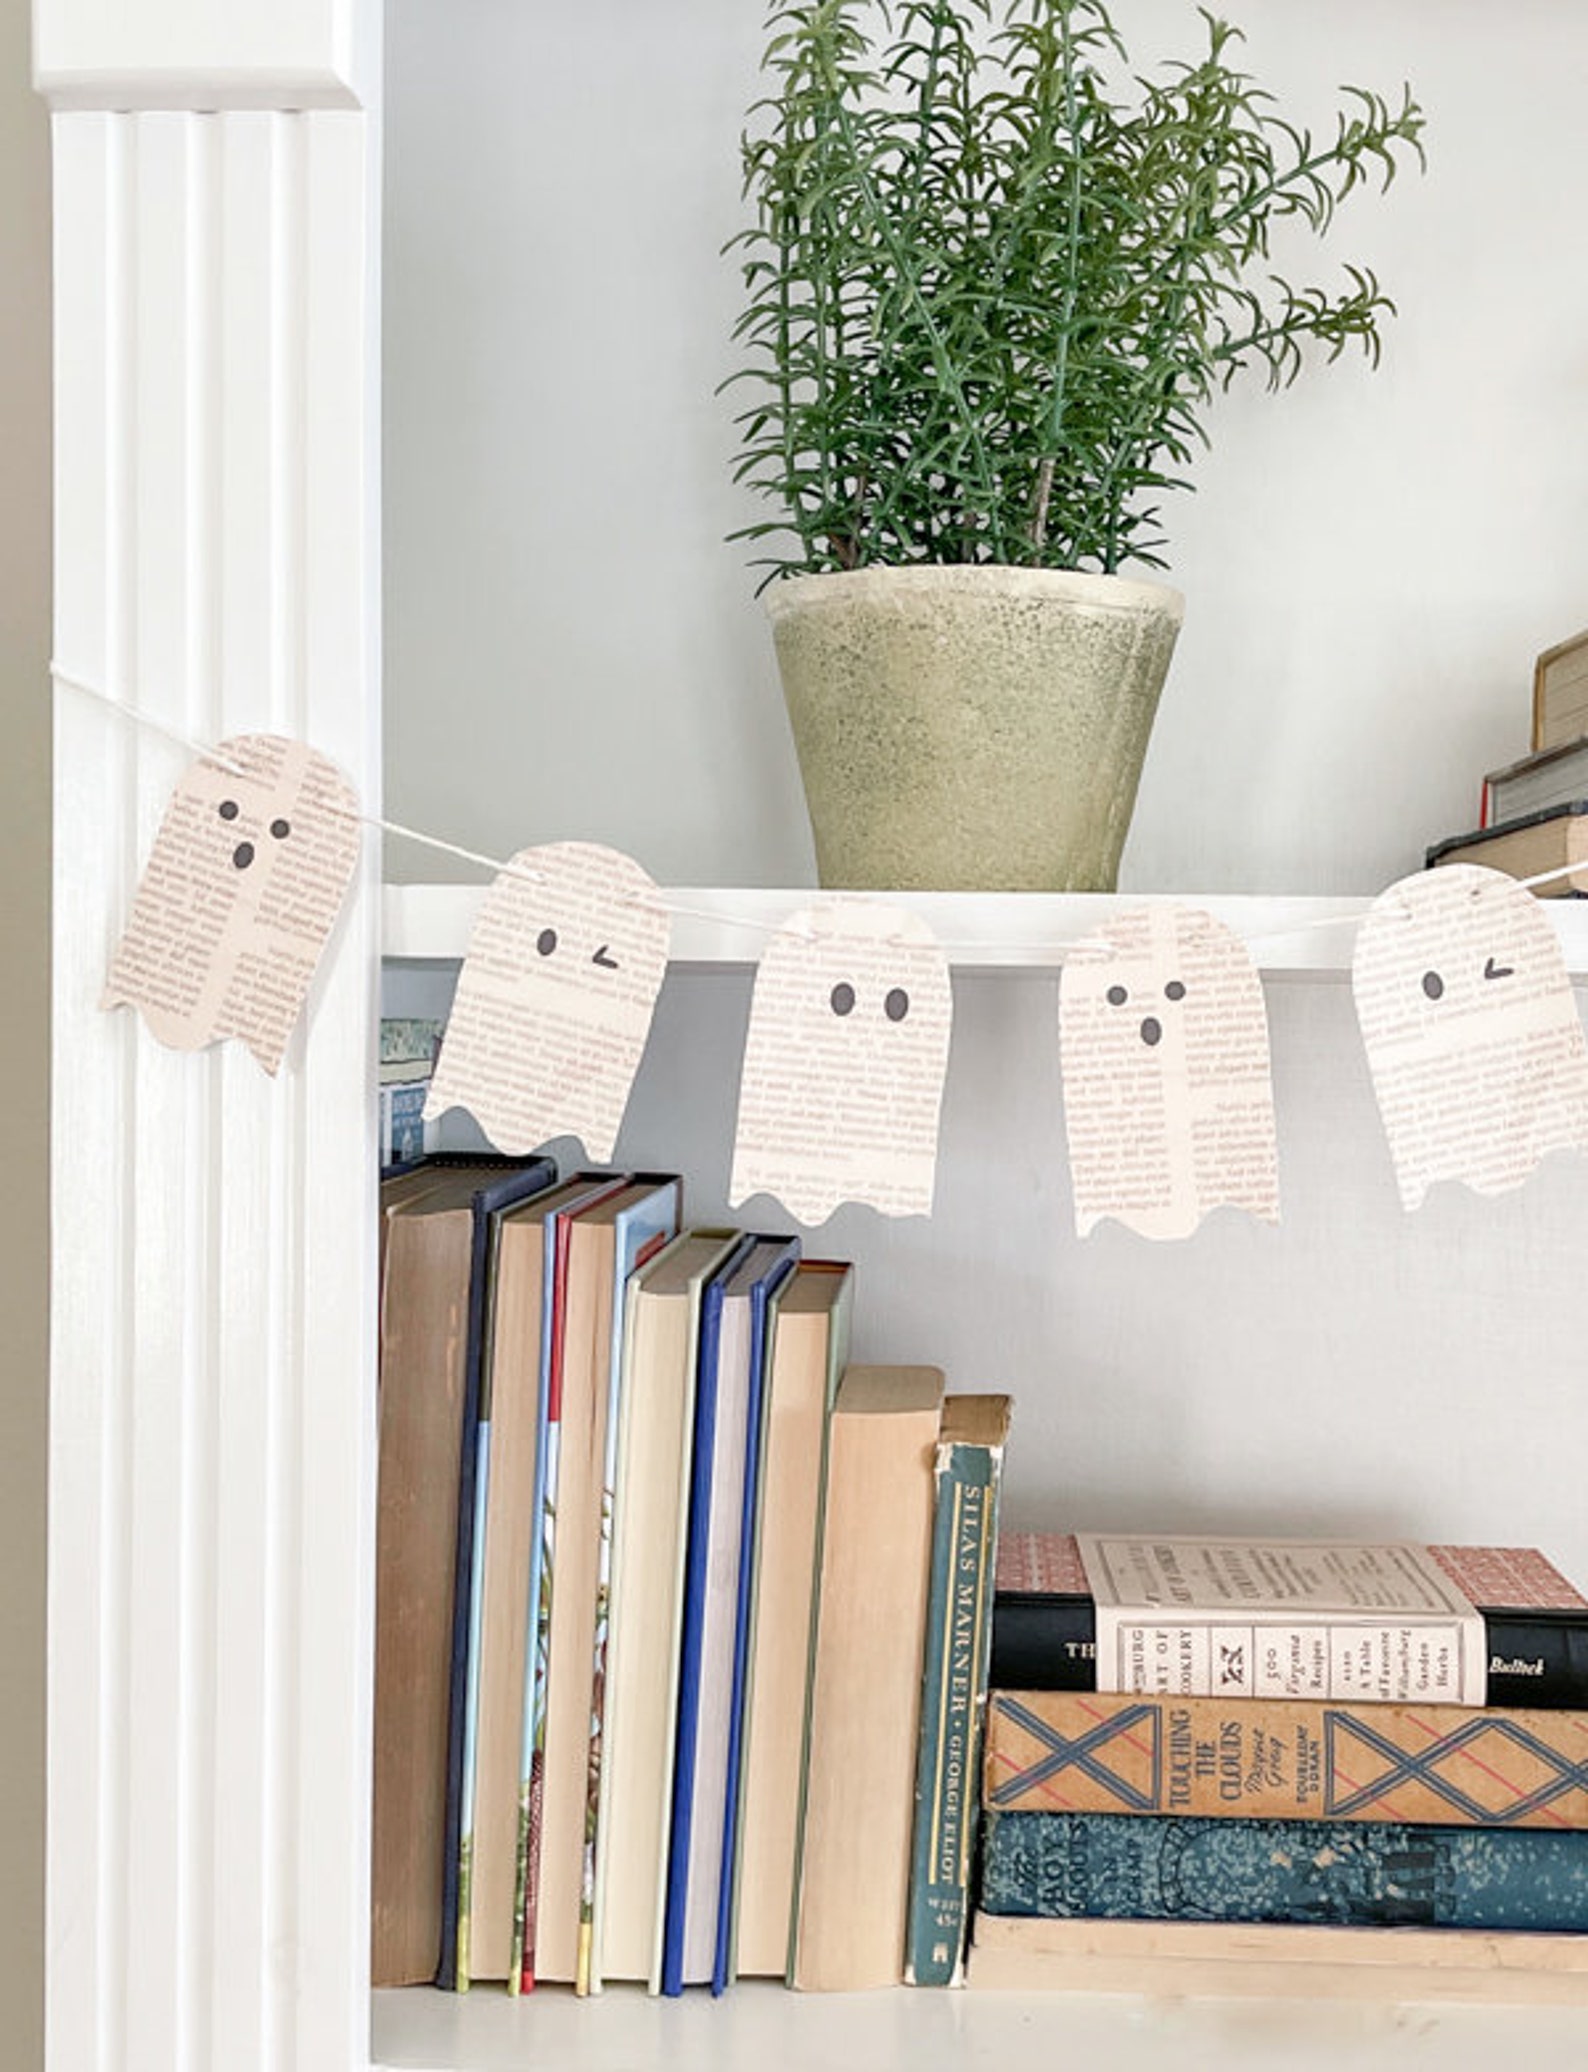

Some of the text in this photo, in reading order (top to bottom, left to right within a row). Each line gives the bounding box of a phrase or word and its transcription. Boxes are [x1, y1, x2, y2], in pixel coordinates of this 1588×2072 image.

[960, 1485, 981, 1571] SILAS
[951, 1584, 974, 1712] MARNER
[1156, 1629, 1168, 1654] OF
[1180, 1629, 1192, 1695] COOKERY
[1266, 1648, 1281, 1680] 500
[1286, 1634, 1305, 1695] Virginia
[1310, 1640, 1327, 1689] Recipes
[1359, 1640, 1372, 1677] Table
[1415, 1643, 1429, 1691] Garden
[944, 1735, 963, 1819] GEORGE
[1170, 1709, 1191, 1808] TOUCHING
[1195, 1740, 1215, 1780] THE
[1220, 1721, 1242, 1800] CLOUDS
[1296, 1725, 1308, 1802] DOUBLEDAY
[1309, 1740, 1319, 1792] DORAN
[941, 1822, 957, 1884] ELIOT
[1042, 1836, 1064, 1902] BOY
[1068, 1820, 1088, 1911] SCOUTS
[1127, 1838, 1142, 1901] CAMP
